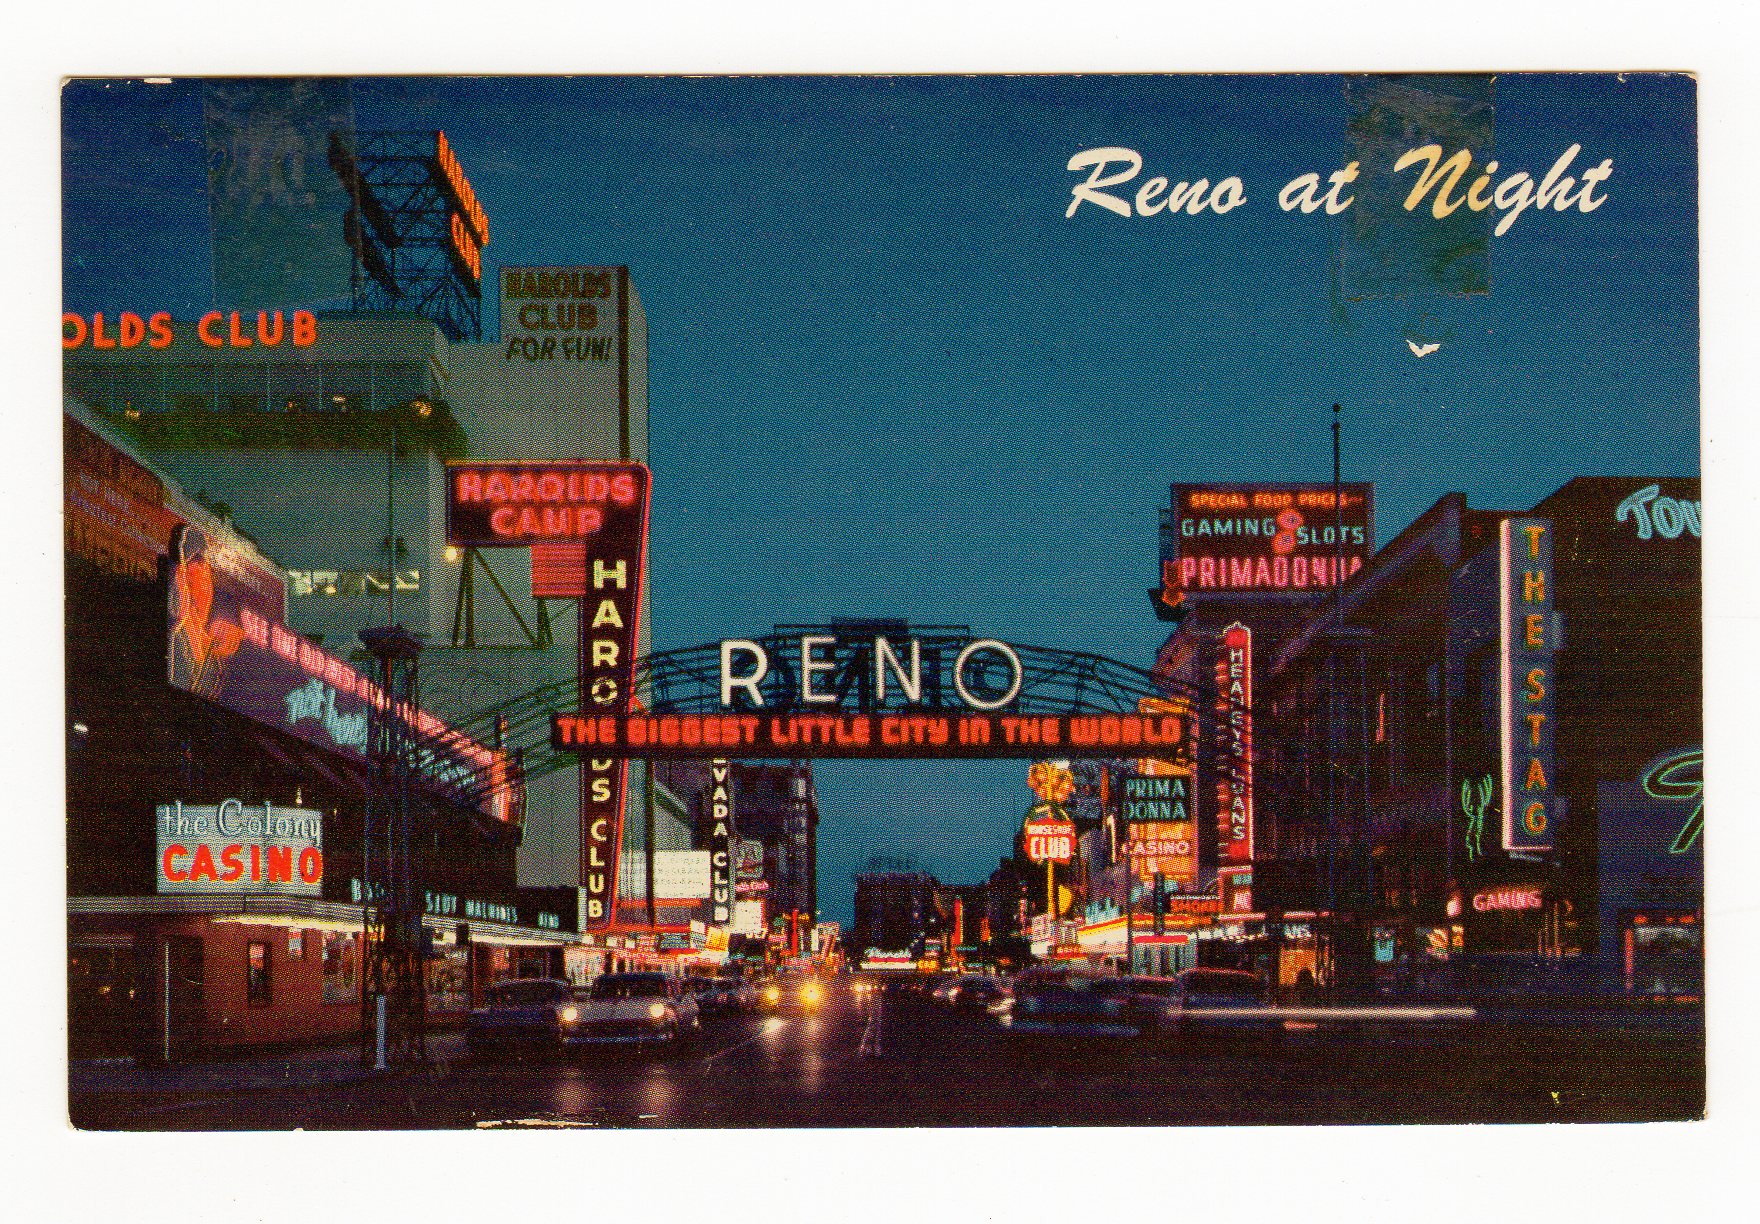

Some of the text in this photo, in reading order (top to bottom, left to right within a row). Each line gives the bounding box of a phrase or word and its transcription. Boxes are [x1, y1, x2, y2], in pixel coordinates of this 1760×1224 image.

[505, 272, 612, 299] HAROLDS
[62, 310, 318, 349] OLDS CLUB
[518, 303, 600, 331] CLUB
[505, 336, 613, 362] FOR FUN!
[457, 472, 637, 504] HAROLDS
[1190, 492, 1249, 508] SPECIAL
[1253, 492, 1294, 508] FOOD
[1181, 518, 1366, 545] GAMING SLOTS
[719, 636, 1025, 710] RENO
[1523, 525, 1549, 836] THE STAG
[557, 716, 1182, 746] THE BIGGEST LITTLE CITY IN THE WORLD
[1125, 778, 1187, 798] PRIMA
[165, 798, 322, 847] the Colony
[1122, 800, 1188, 821] DONNA
[1030, 837, 1071, 859] CLUB
[1121, 841, 1191, 855] CASINO
[162, 844, 324, 884] CASINO
[587, 820, 608, 918] CLUB
[713, 851, 730, 922] CLUB
